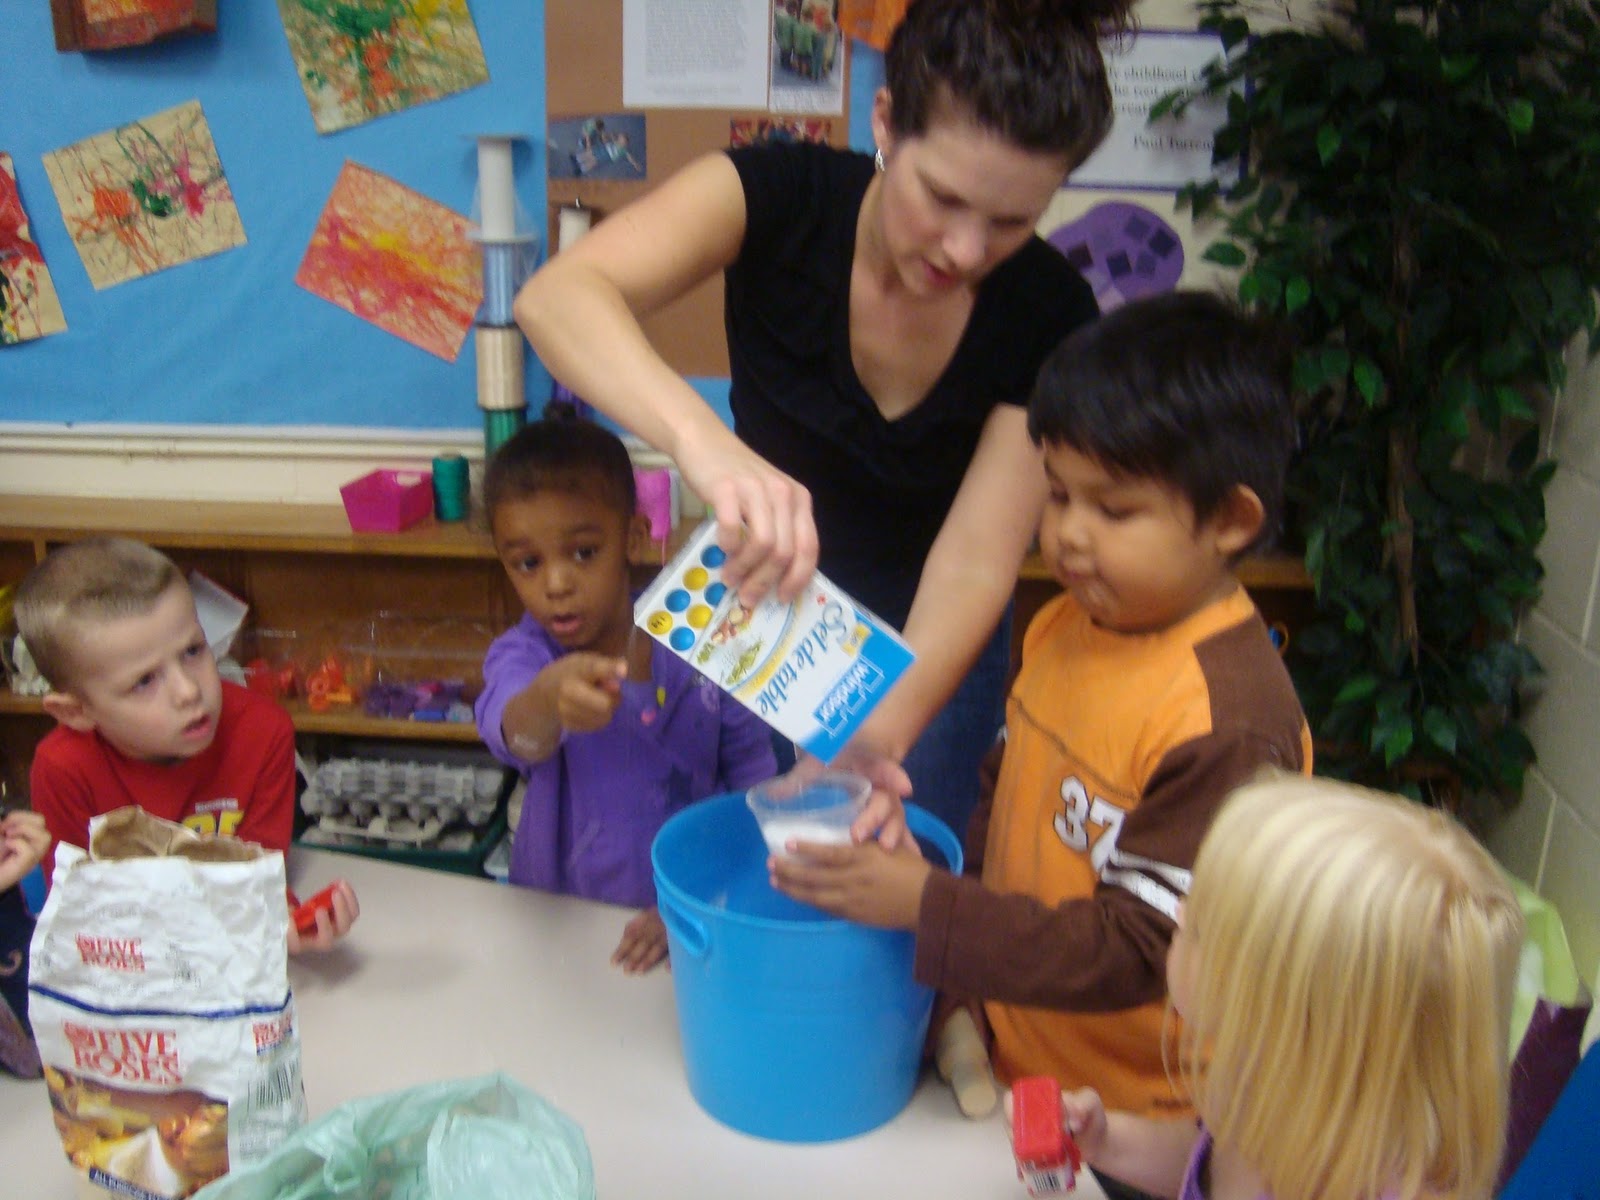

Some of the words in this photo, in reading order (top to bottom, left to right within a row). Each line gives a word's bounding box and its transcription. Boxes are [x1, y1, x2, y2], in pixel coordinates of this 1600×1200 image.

[792, 639, 815, 668] de
[814, 602, 846, 653] Sel
[755, 661, 798, 714] table
[1054, 776, 1125, 872] 37
[64, 1028, 182, 1084] ROSES
[98, 1028, 176, 1056] FIVE
